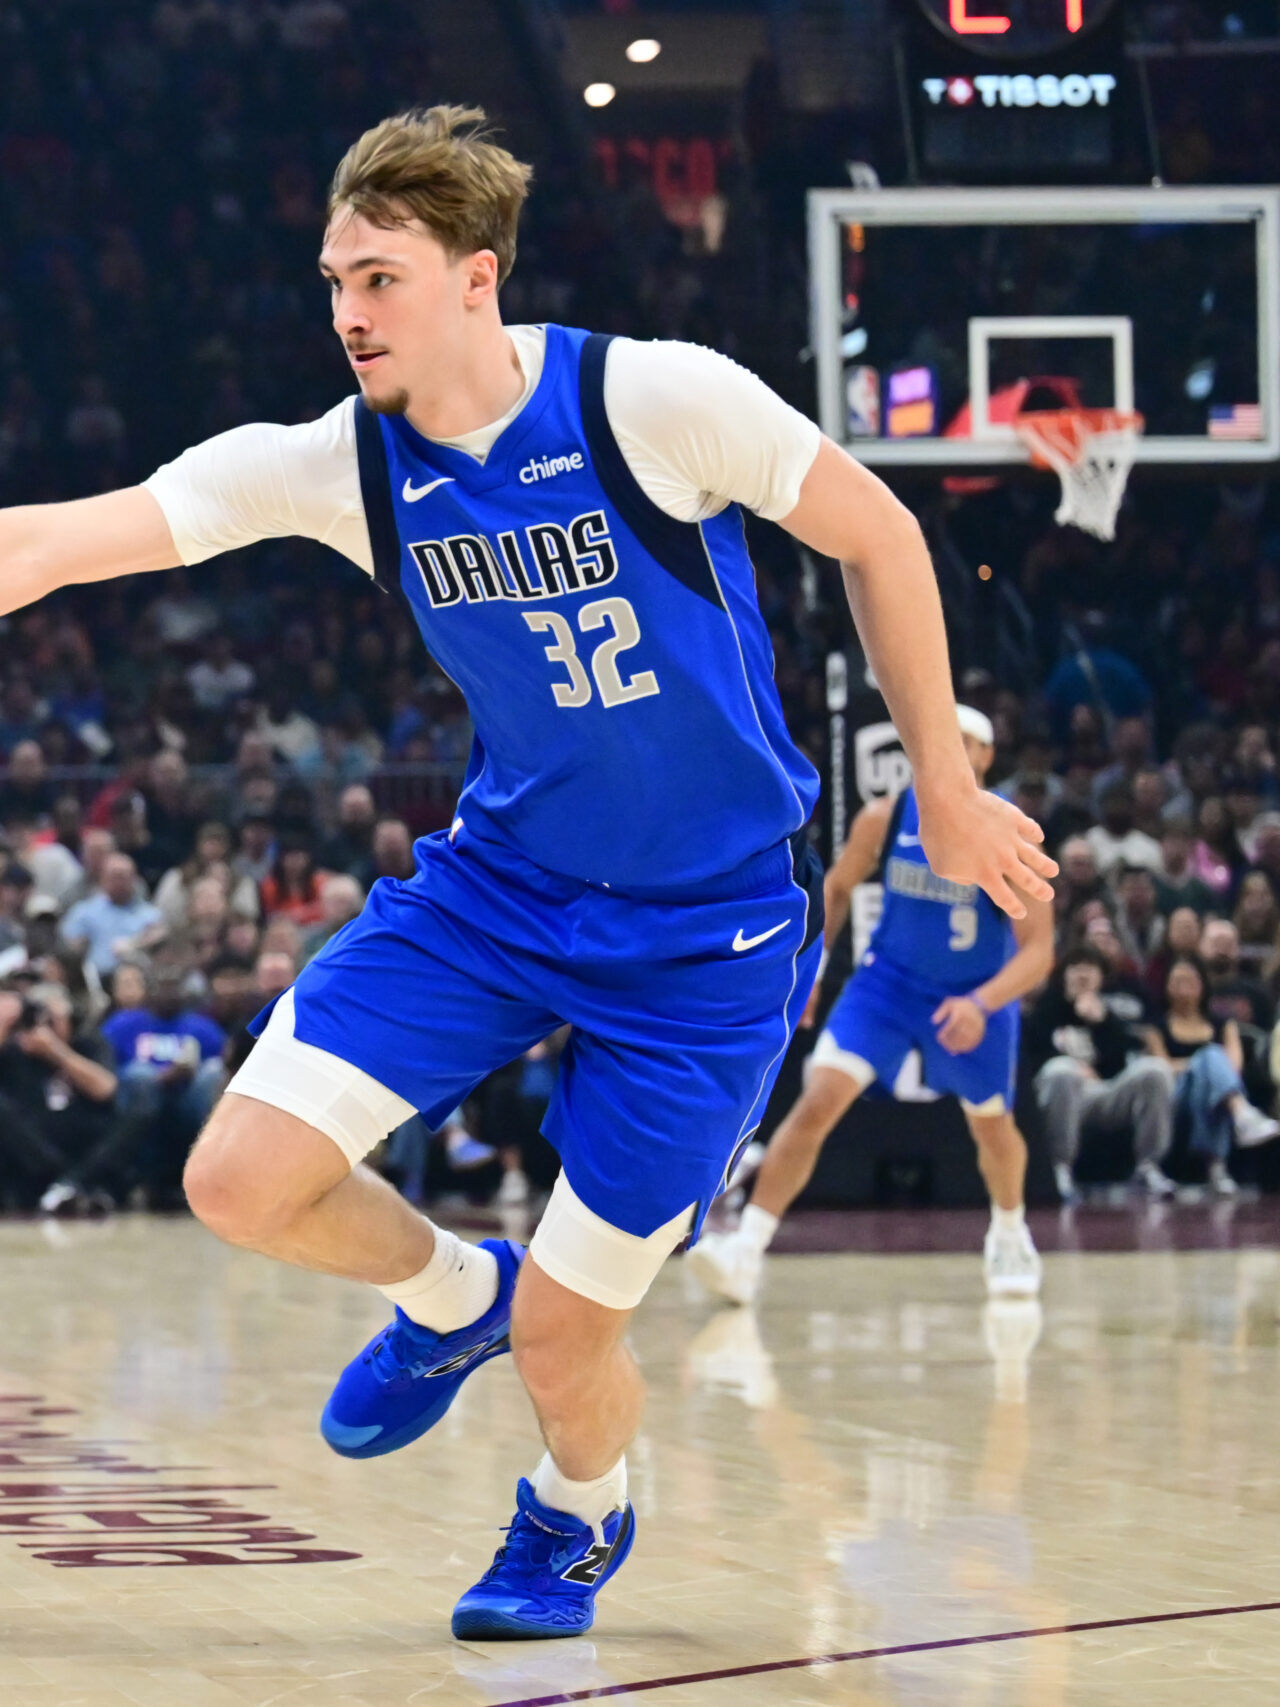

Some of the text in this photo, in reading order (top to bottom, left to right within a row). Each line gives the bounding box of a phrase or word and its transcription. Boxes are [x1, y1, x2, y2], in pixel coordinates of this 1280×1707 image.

[973, 74, 1116, 107] TISSOT
[519, 452, 584, 484] chime
[408, 509, 618, 609] DALLAS
[521, 597, 660, 708] 32
[949, 906, 978, 951] 9
